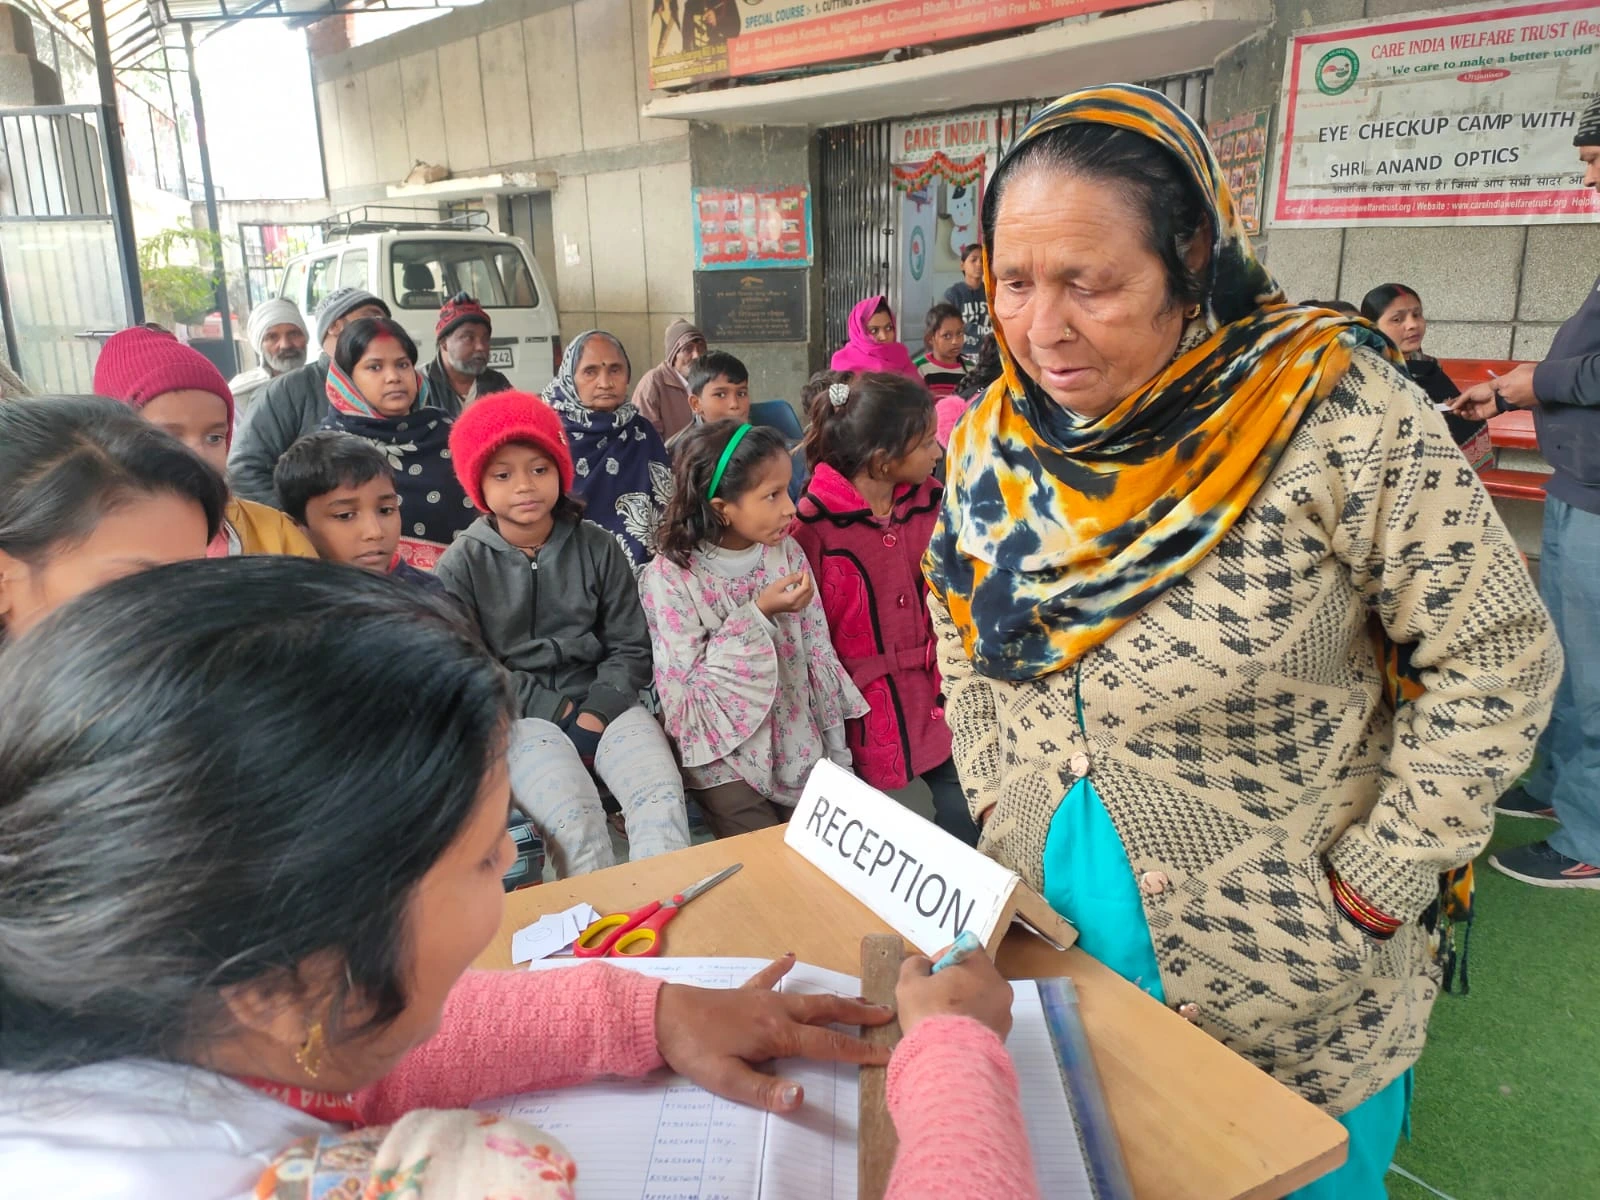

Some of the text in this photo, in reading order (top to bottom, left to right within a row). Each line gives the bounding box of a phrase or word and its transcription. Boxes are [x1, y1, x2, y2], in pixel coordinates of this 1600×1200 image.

[744, 12, 774, 29] SPECIAL
[775, 5, 805, 24] COURSE
[1371, 41, 1406, 60] CARE
[1408, 37, 1445, 55] INDIA
[1450, 29, 1517, 50] WELFARE
[1520, 22, 1569, 42] TRUST
[1414, 64, 1440, 74] care
[1444, 61, 1456, 69] to
[1460, 56, 1494, 68] make
[1510, 48, 1550, 63] better
[904, 125, 941, 153] CARE
[944, 119, 989, 148] INDIA
[1318, 111, 1576, 143] EYE CHECKUP CAMP WITH
[1330, 147, 1520, 178] SHRI ANAND OPTICS
[489, 351, 511, 364] 242
[806, 796, 976, 939] RECEPTION
